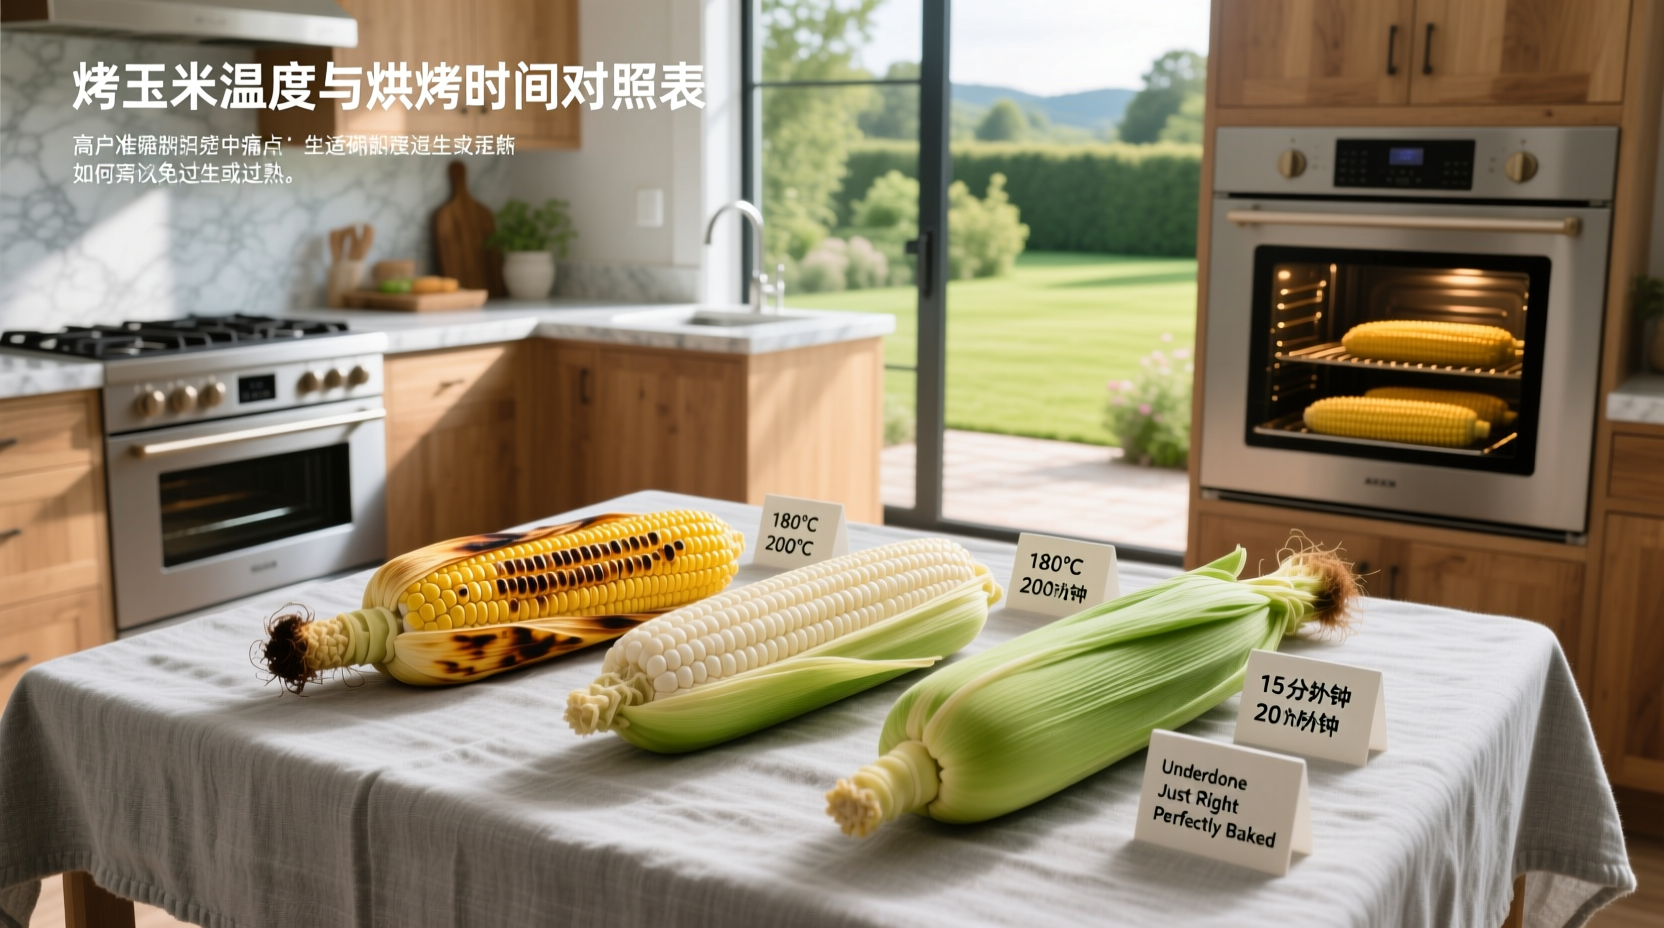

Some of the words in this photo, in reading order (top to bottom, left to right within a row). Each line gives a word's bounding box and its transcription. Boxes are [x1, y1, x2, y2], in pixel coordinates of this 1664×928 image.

[1162, 759, 1248, 791] Underdone
[1157, 783, 1192, 804] Just
[1195, 790, 1239, 816] Right
[1153, 806, 1222, 839] Perfectly
[1226, 823, 1276, 848] Baked
